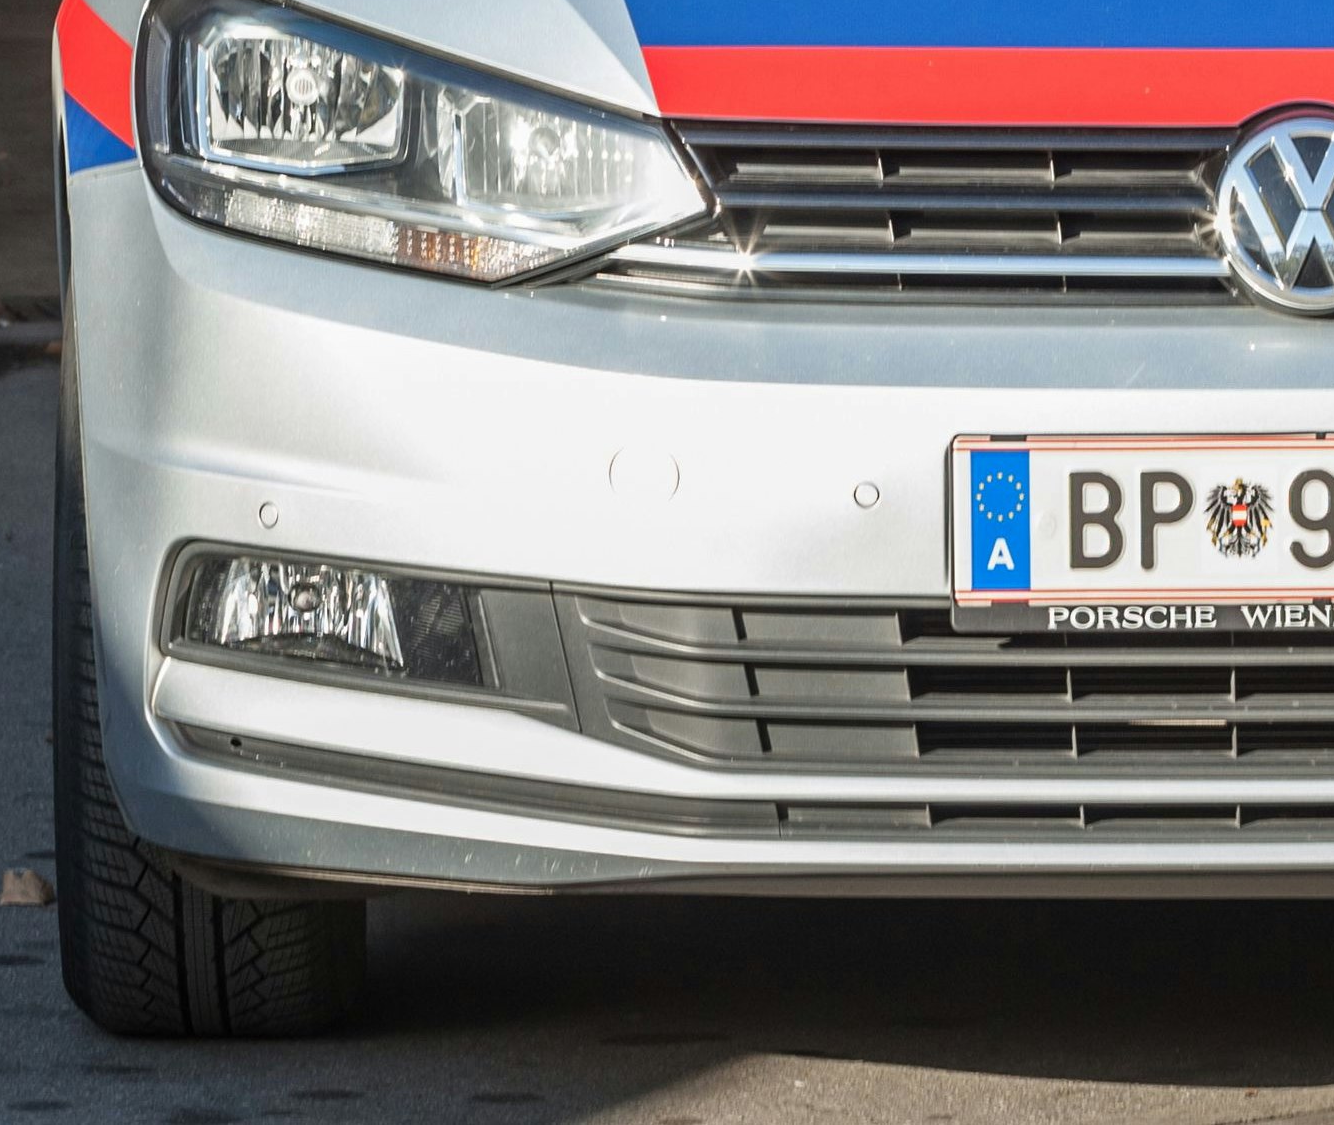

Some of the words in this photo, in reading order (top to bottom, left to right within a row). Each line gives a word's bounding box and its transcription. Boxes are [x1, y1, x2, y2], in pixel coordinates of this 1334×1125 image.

[1068, 470, 1195, 572] BP
[986, 537, 1015, 571] A
[1047, 605, 1218, 631] PORSCHE
